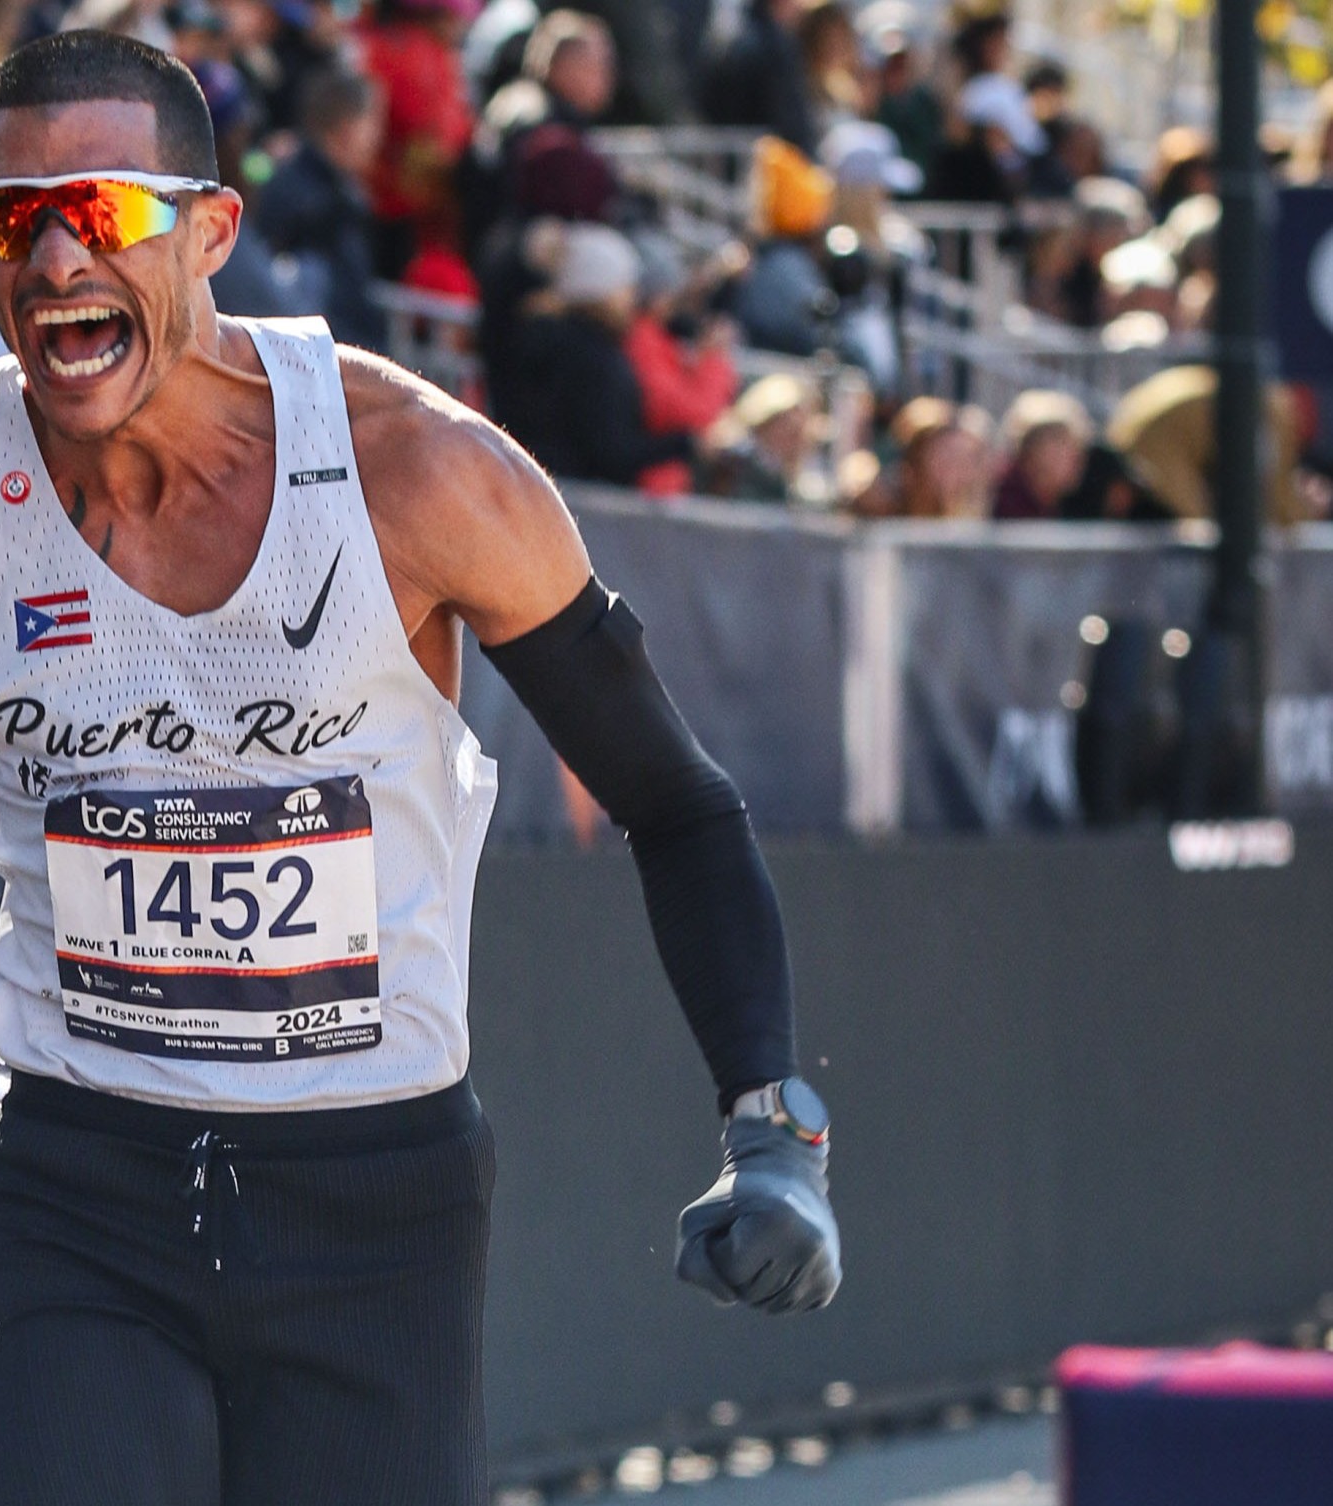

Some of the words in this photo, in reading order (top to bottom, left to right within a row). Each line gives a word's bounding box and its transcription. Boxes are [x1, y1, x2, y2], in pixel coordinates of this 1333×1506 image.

[153, 798, 196, 812] TATA
[80, 796, 147, 839] tcs
[154, 811, 252, 827] CONSULTANCY
[277, 813, 330, 835] TATA
[155, 827, 217, 841] SERVICES
[104, 855, 317, 941] 1452
[65, 934, 105, 953] WAVE
[109, 940, 120, 957] 1
[132, 945, 168, 958] BLUE
[172, 946, 233, 961] CORRAL
[237, 947, 255, 964] A
[95, 1003, 220, 1030] #TCSNYCMarathon
[276, 1004, 343, 1034] 2024
[165, 1038, 182, 1048] BUS
[275, 1038, 290, 1055] B
[303, 1035, 316, 1045] FOR
[315, 1041, 332, 1051] CALL
